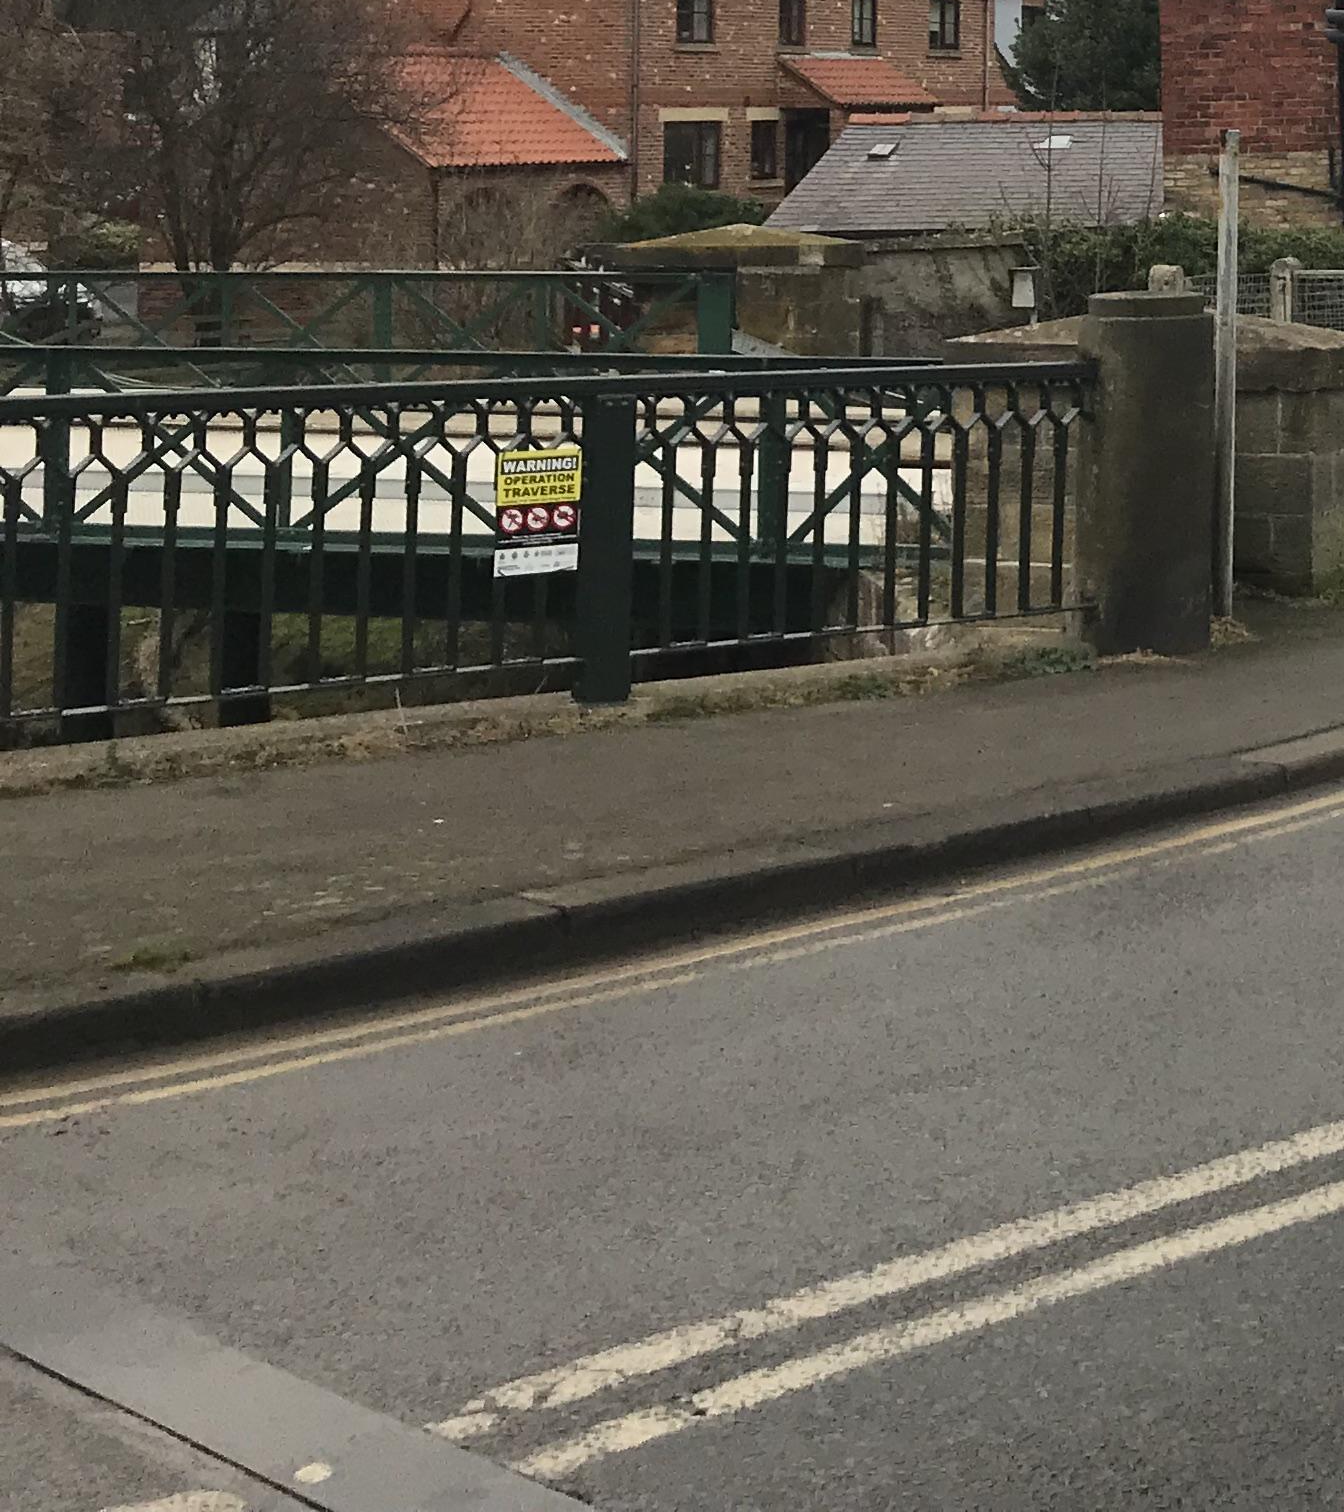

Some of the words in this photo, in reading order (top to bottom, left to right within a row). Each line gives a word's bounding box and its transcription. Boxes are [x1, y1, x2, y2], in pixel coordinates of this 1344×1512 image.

[503, 457, 577, 473] WARNING!
[504, 473, 575, 486] OPERATION
[503, 484, 575, 498] TRAVERSE
